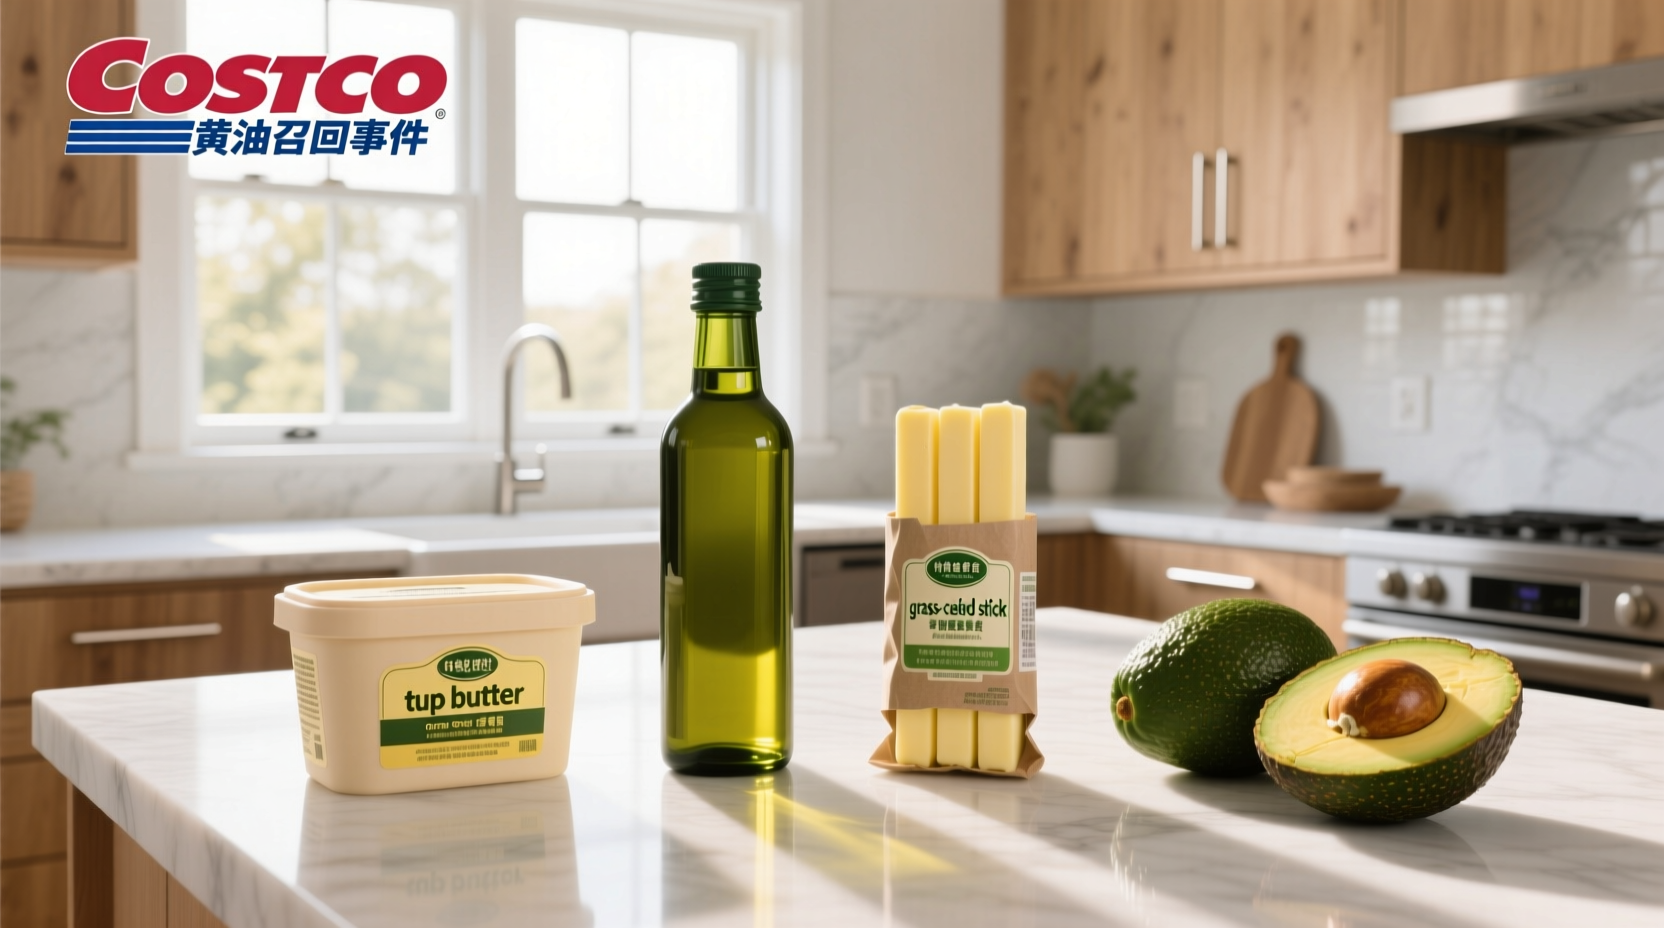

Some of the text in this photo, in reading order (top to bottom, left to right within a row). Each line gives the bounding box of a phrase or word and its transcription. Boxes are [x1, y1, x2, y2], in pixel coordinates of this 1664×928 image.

[978, 598, 1007, 617] stick
[404, 684, 525, 715] tup butter
